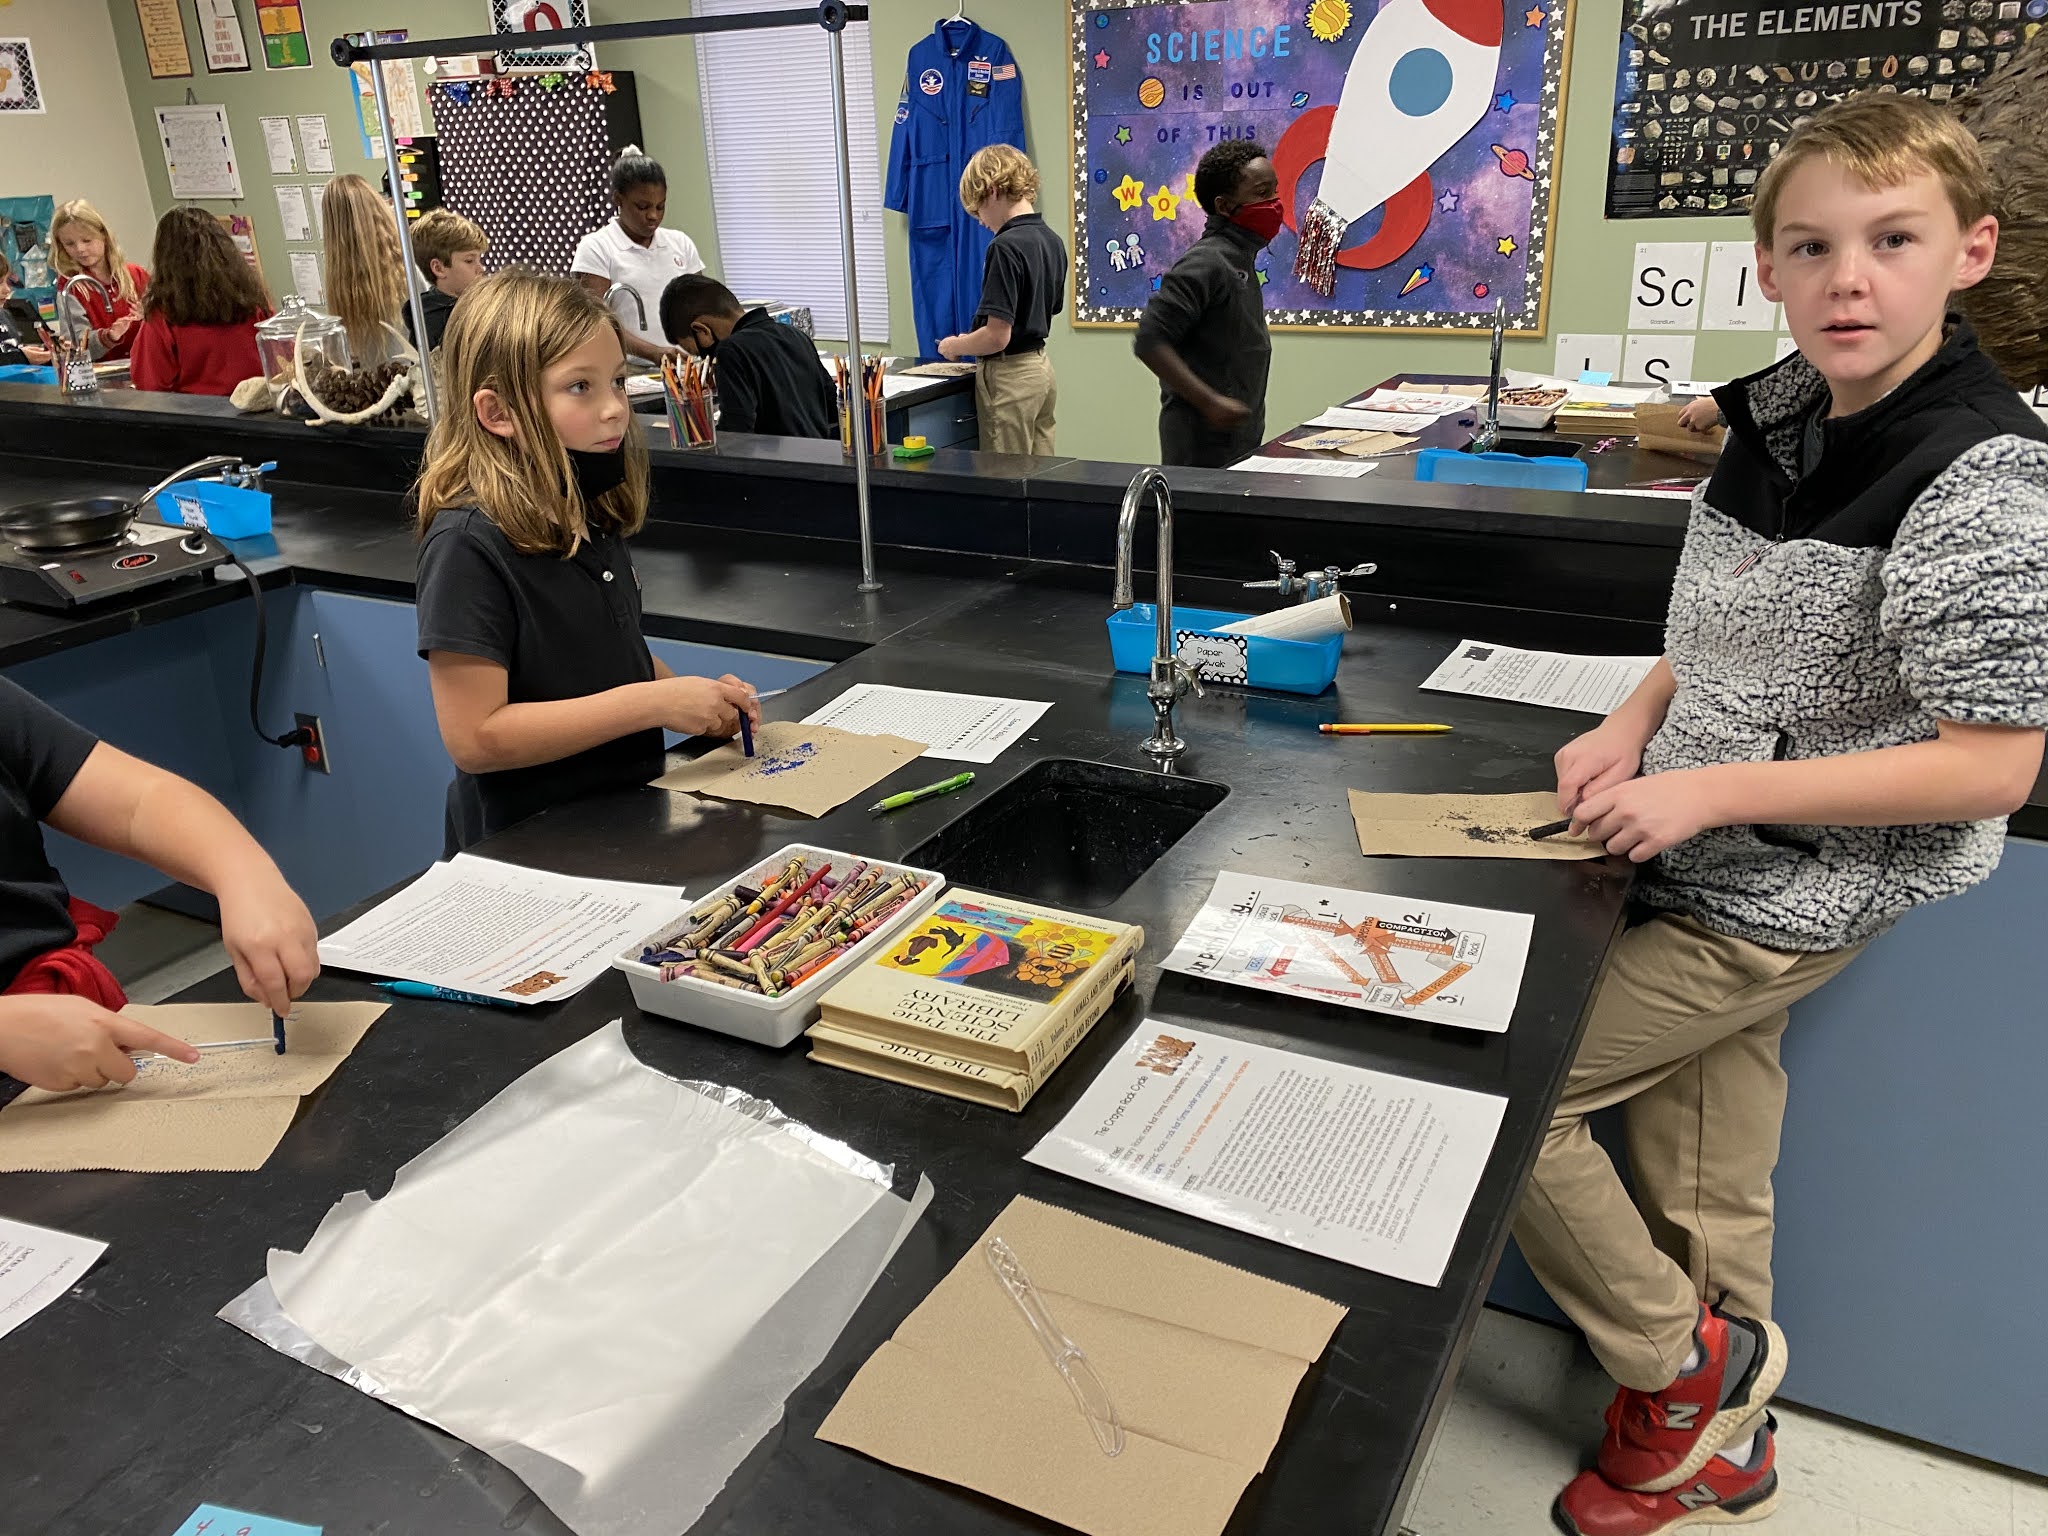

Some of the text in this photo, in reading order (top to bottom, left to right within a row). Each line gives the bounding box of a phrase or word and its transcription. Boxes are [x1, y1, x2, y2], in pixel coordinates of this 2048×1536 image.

[1690, 0, 1922, 40] THE ELEMENTS
[1146, 25, 1291, 64] SCIENCE
[1183, 82, 1275, 100] IS OUT
[1157, 125, 1256, 143] OF THIS
[1637, 267, 1695, 307] Sc
[1737, 267, 1748, 306] I
[1197, 647, 1223, 657] Paper
[1197, 657, 1226, 668] Twels
[1287, 916, 1344, 929] WEATHERING
[1378, 922, 1448, 938] COMPACTION
[1403, 912, 1425, 924] 2.
[594, 936, 618, 949] Crayon
[1455, 934, 1469, 959] Sedimentary
[1467, 942, 1480, 957] Rock
[1432, 965, 1467, 991] PRESSURE
[903, 988, 1022, 1022] LIBRARY
[1050, 1024, 1065, 1045] Volume
[1073, 995, 1090, 1019] ANIMALS
[1090, 985, 1098, 998] AND
[1098, 972, 1110, 989] THEIR
[1109, 962, 1120, 977] CARE
[1436, 994, 1459, 1004] 3.
[892, 1009, 1000, 1043] The True
[898, 999, 1013, 1033] SCIENCE
[1039, 1059, 1055, 1079] Volume
[1062, 1034, 1076, 1053] ABOVE
[1076, 1025, 1085, 1039] AND
[1085, 1006, 1100, 1029] BEYOND
[880, 1043, 988, 1078] The True
[1094, 1075, 1148, 1135] The Crayon Rock Cycle
